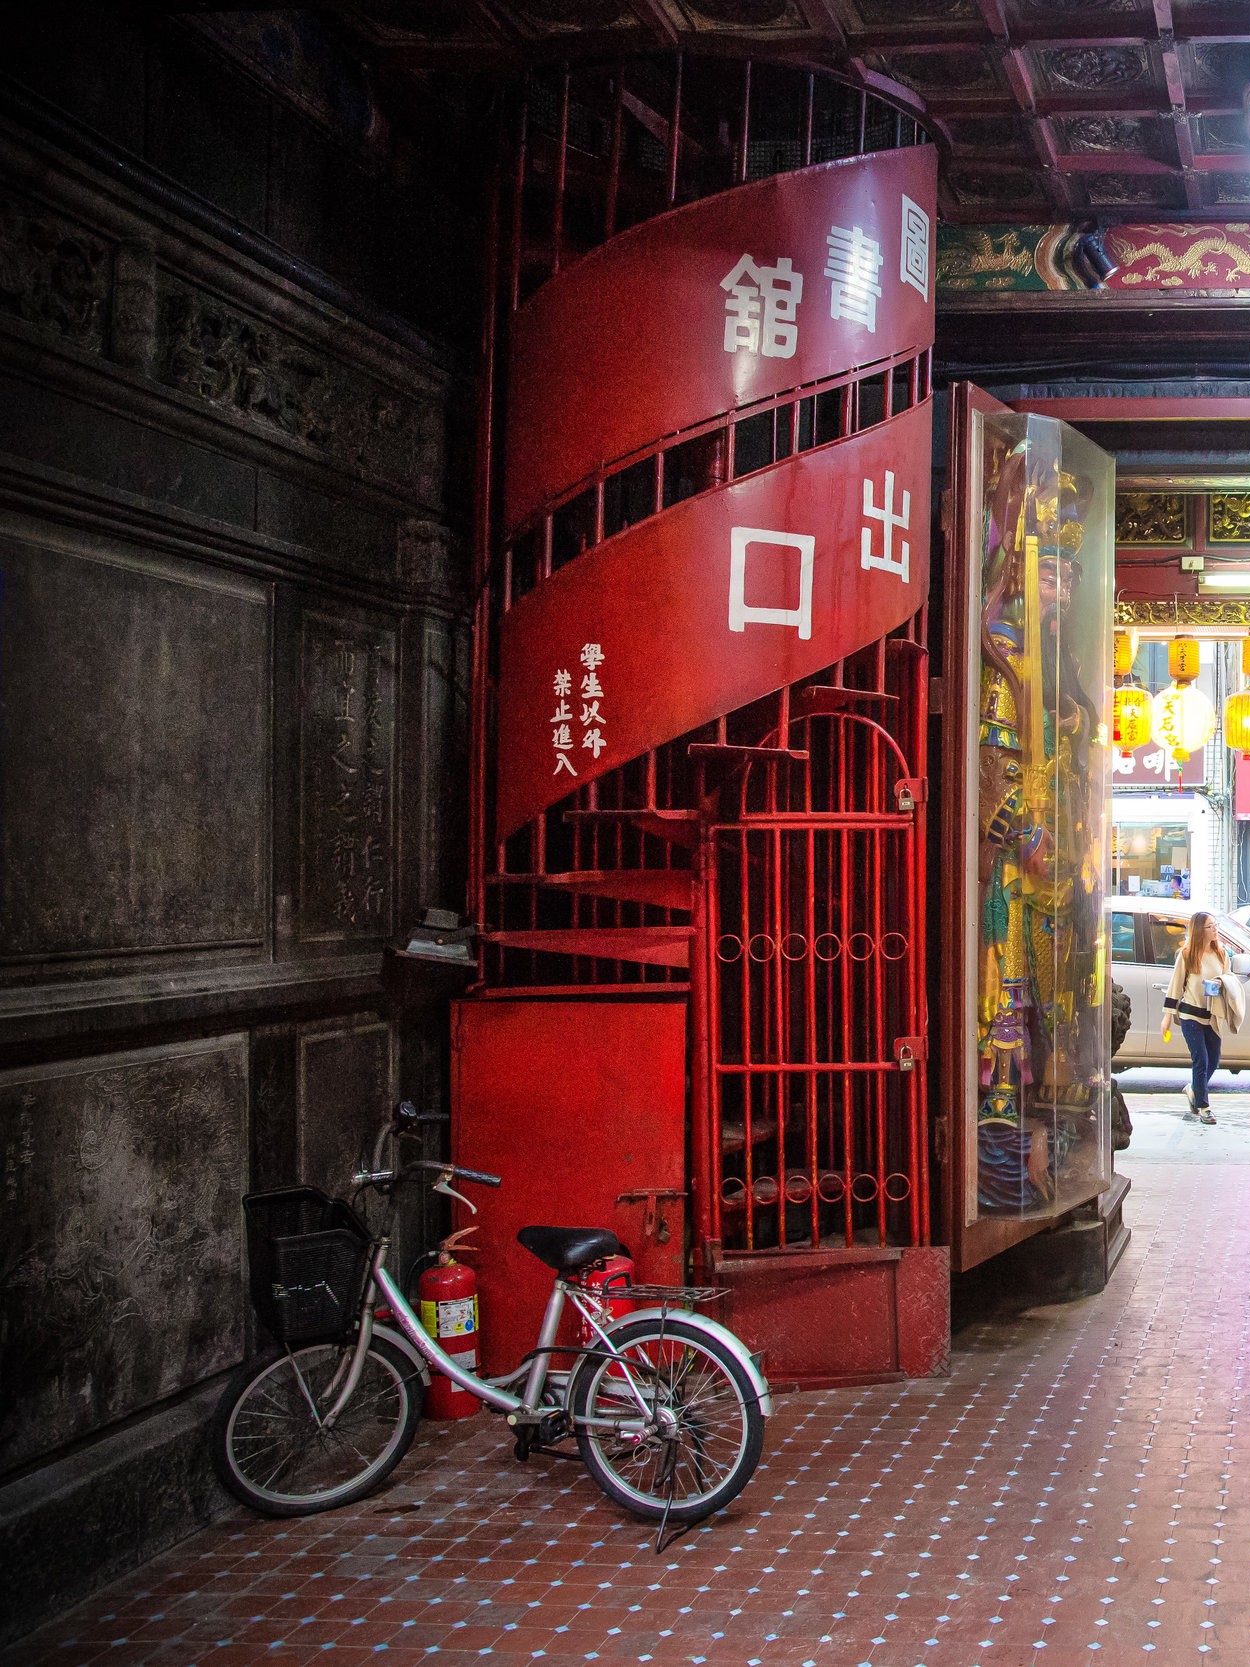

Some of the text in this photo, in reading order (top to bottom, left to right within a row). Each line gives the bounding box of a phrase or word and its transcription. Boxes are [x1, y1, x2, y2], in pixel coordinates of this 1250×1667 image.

[728, 469, 911, 640] 出口
[550, 669, 578, 777] 禁止進入
[580, 643, 607, 759] 學生以外
